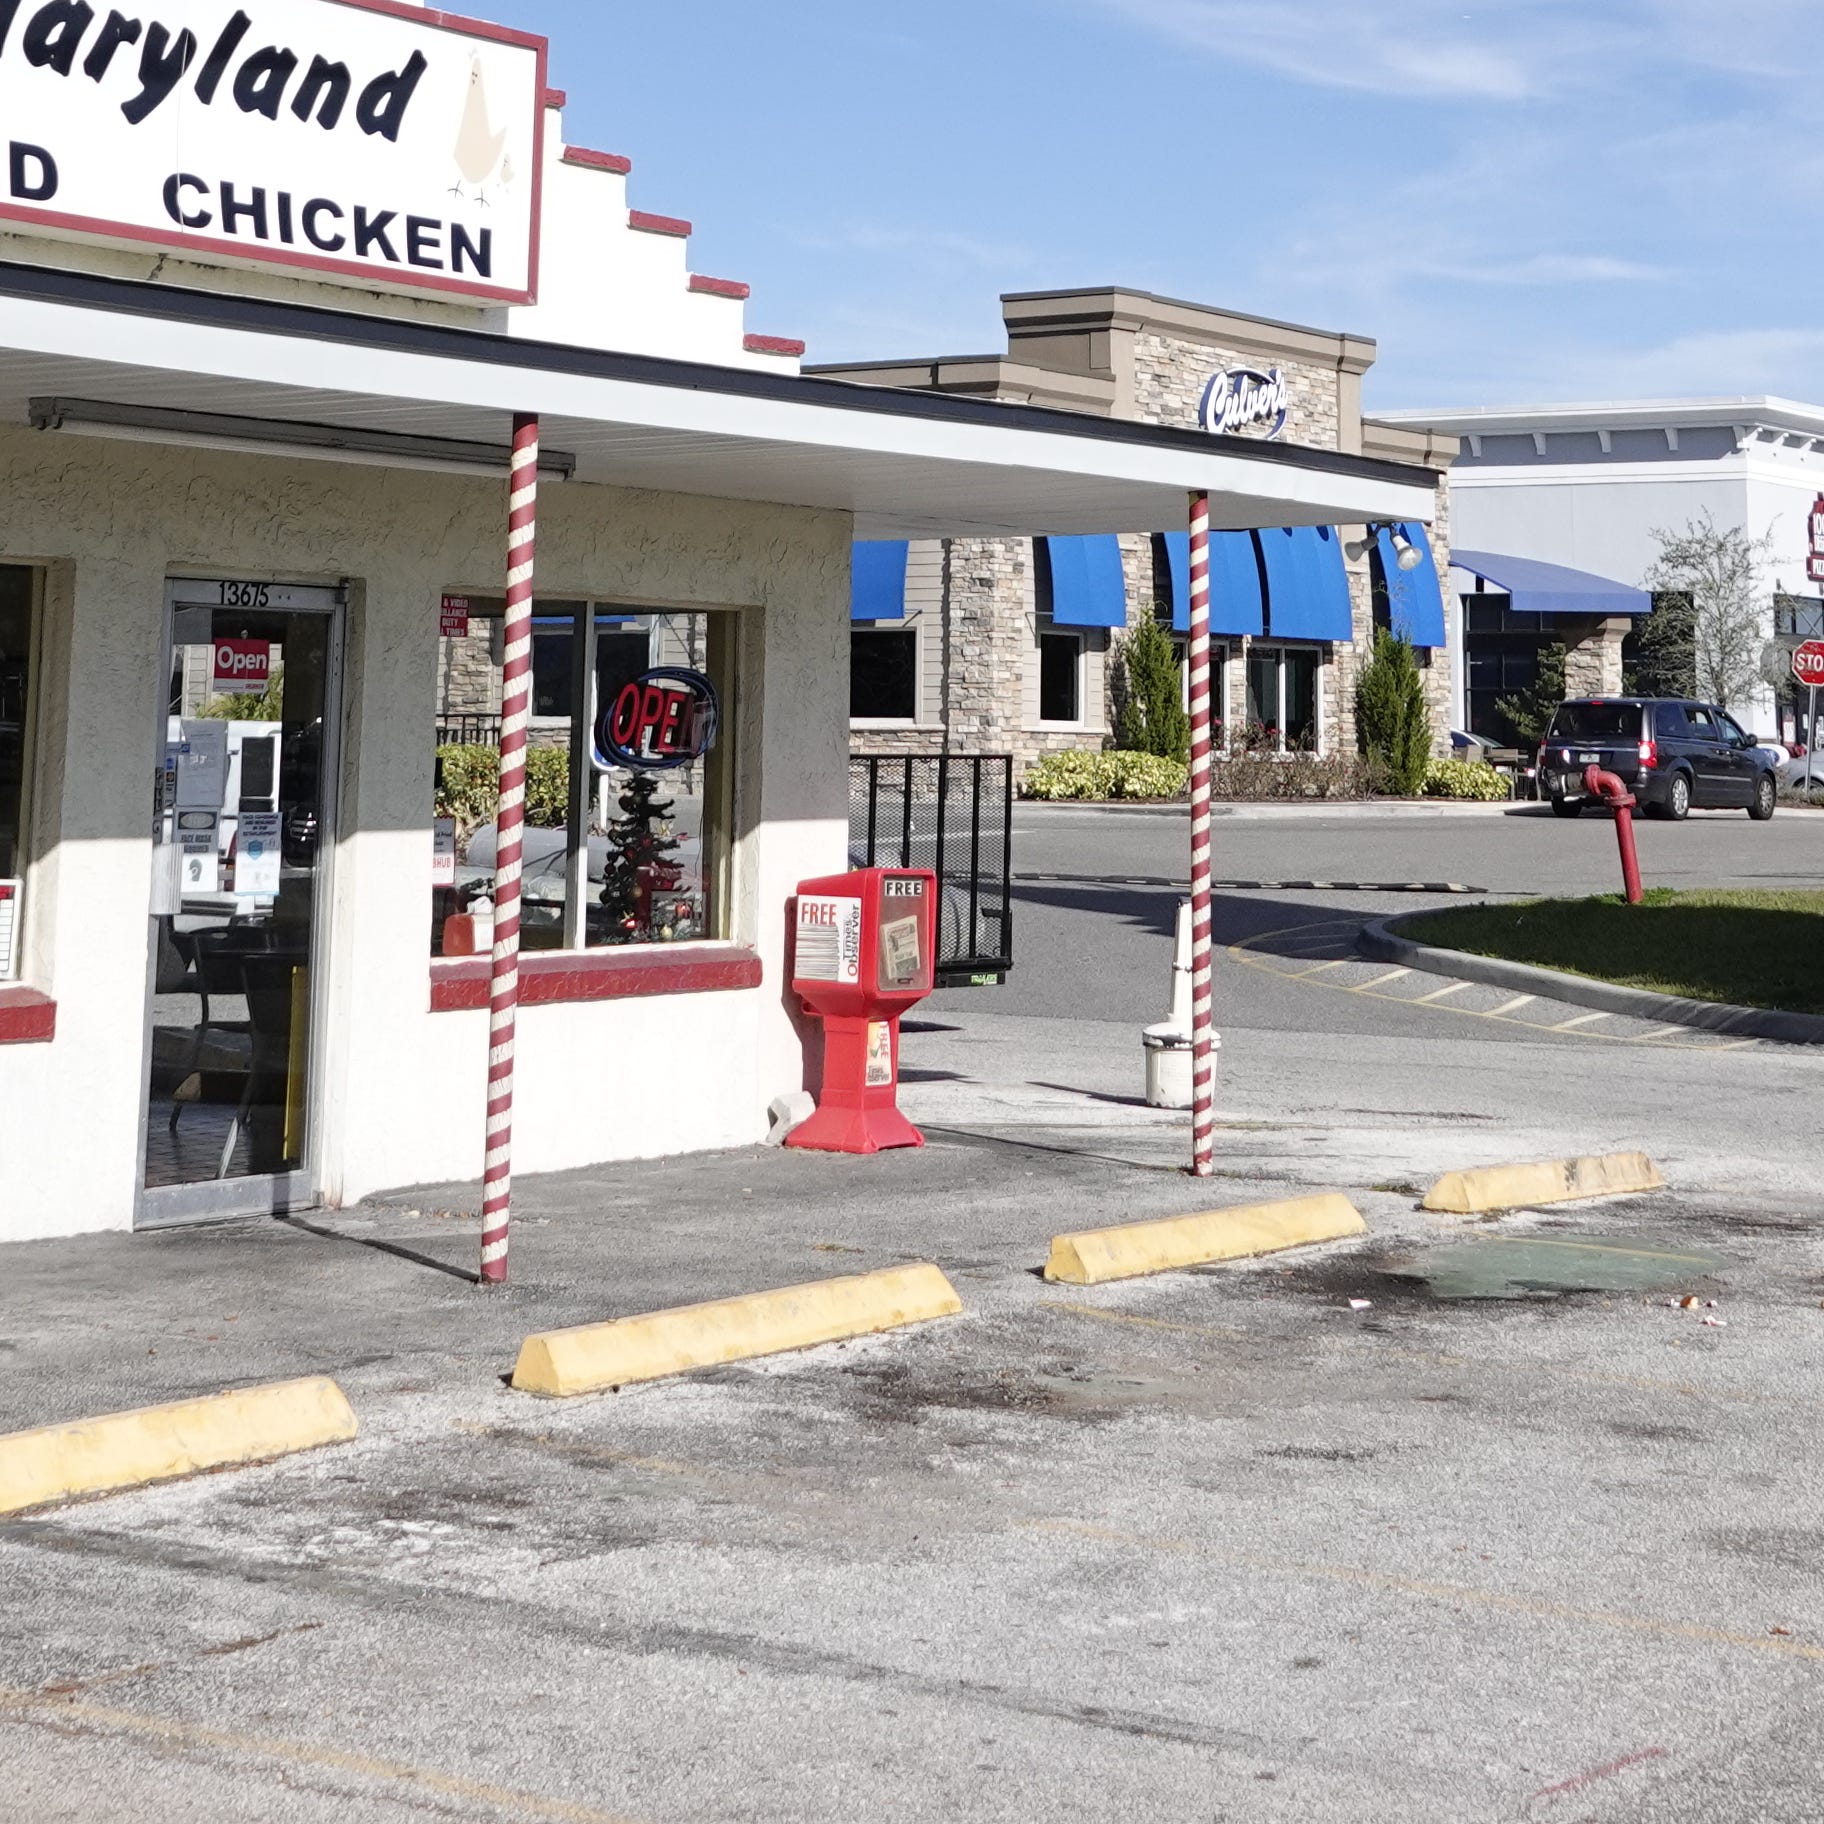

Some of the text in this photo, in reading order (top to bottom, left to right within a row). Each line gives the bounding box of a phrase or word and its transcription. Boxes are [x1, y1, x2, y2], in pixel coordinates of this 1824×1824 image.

[164, 173, 493, 278] CHICKEN
[1206, 368, 1288, 434] Culver's
[218, 582, 270, 607] 13675
[442, 617, 458, 627] DUTY
[217, 646, 267, 675] Open
[887, 881, 922, 896] FREE
[801, 902, 837, 926] FREE
[843, 919, 854, 960] Times
[847, 904, 861, 977] Observer
